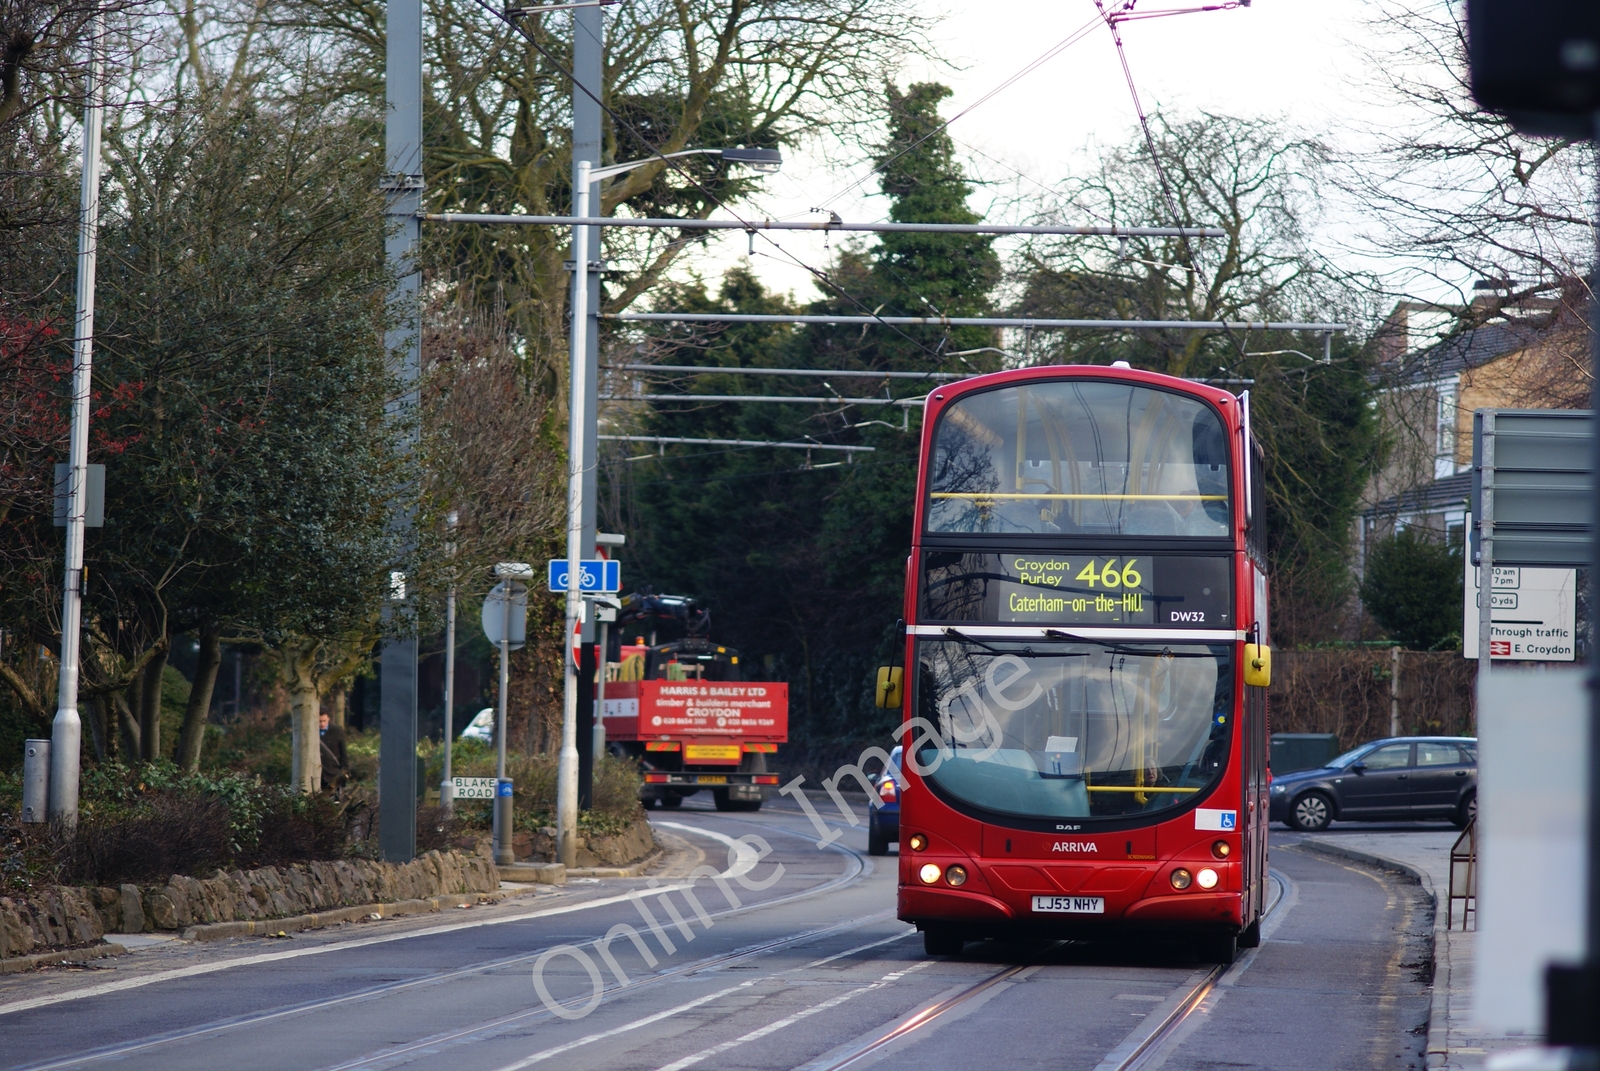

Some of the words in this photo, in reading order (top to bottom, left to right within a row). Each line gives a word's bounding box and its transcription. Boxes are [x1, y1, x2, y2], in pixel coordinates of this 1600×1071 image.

[1014, 558, 1070, 573] Croydon
[1075, 558, 1142, 588] 466
[1020, 572, 1063, 587] Purley
[1494, 576, 1499, 584] 7
[1009, 593, 1144, 612] Caterham-on-the-Hill
[1499, 597, 1514, 606] yds
[1170, 611, 1205, 623] DW32
[1490, 627, 1532, 638] Through
[1536, 628, 1569, 638] traffic
[1514, 644, 1525, 653] E.
[1526, 644, 1571, 655] Croydon
[660, 686, 698, 696] HARRIS
[699, 686, 708, 696] &
[709, 687, 746, 697] BAILEY
[747, 687, 767, 697] LTD
[656, 698, 685, 707] timber
[686, 698, 694, 707] &
[695, 698, 729, 708] builders
[730, 699, 772, 709] merchant
[686, 707, 741, 717] CROYDON
[663, 717, 676, 725] 020
[728, 718, 740, 726] 020
[455, 778, 495, 787] BLAKE
[459, 788, 492, 798] ROAD
[1052, 841, 1098, 853] ARRIVA
[1037, 898, 1071, 911] LJ53
[1074, 899, 1099, 912] NHY
